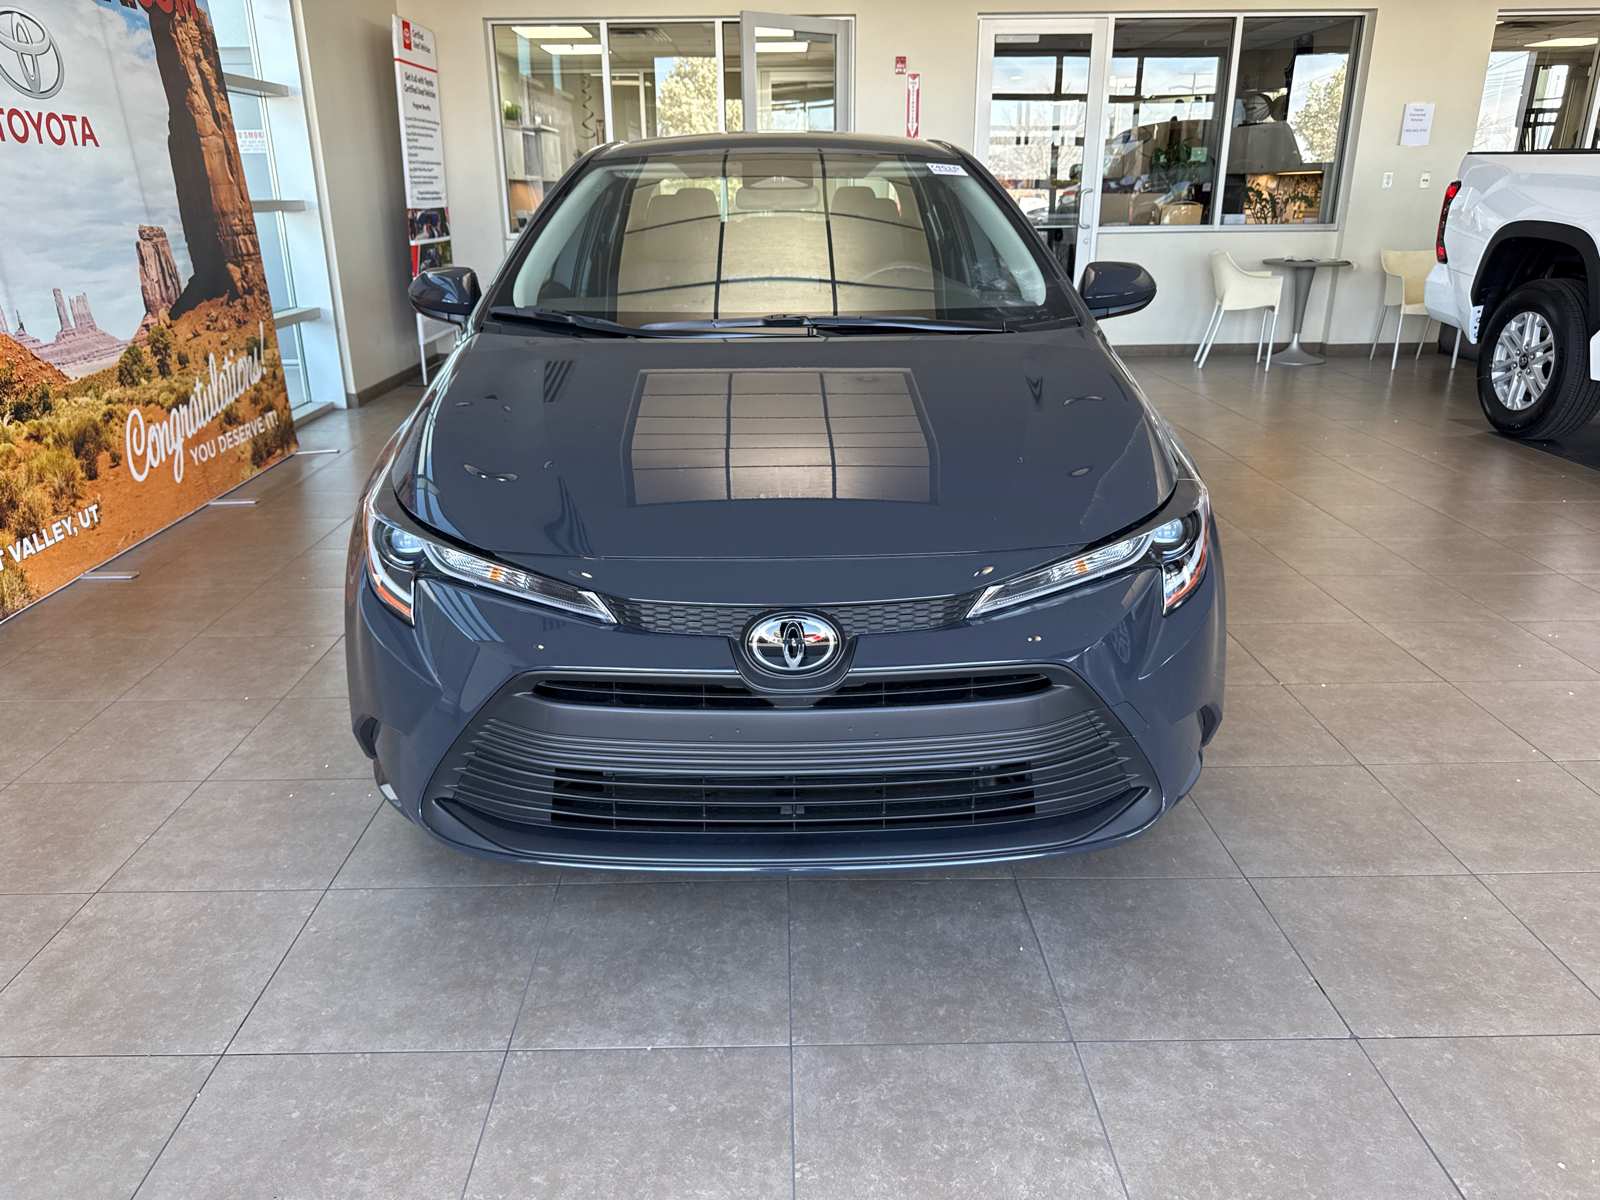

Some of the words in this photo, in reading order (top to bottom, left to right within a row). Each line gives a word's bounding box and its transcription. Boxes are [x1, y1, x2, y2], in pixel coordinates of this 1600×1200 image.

[126, 321, 267, 483] Congratulations!
[189, 439, 217, 466] YOU
[217, 418, 265, 454] DESERVE
[264, 410, 280, 430] IT!
[7, 515, 79, 564] VALLEY,
[77, 503, 100, 529] UT
